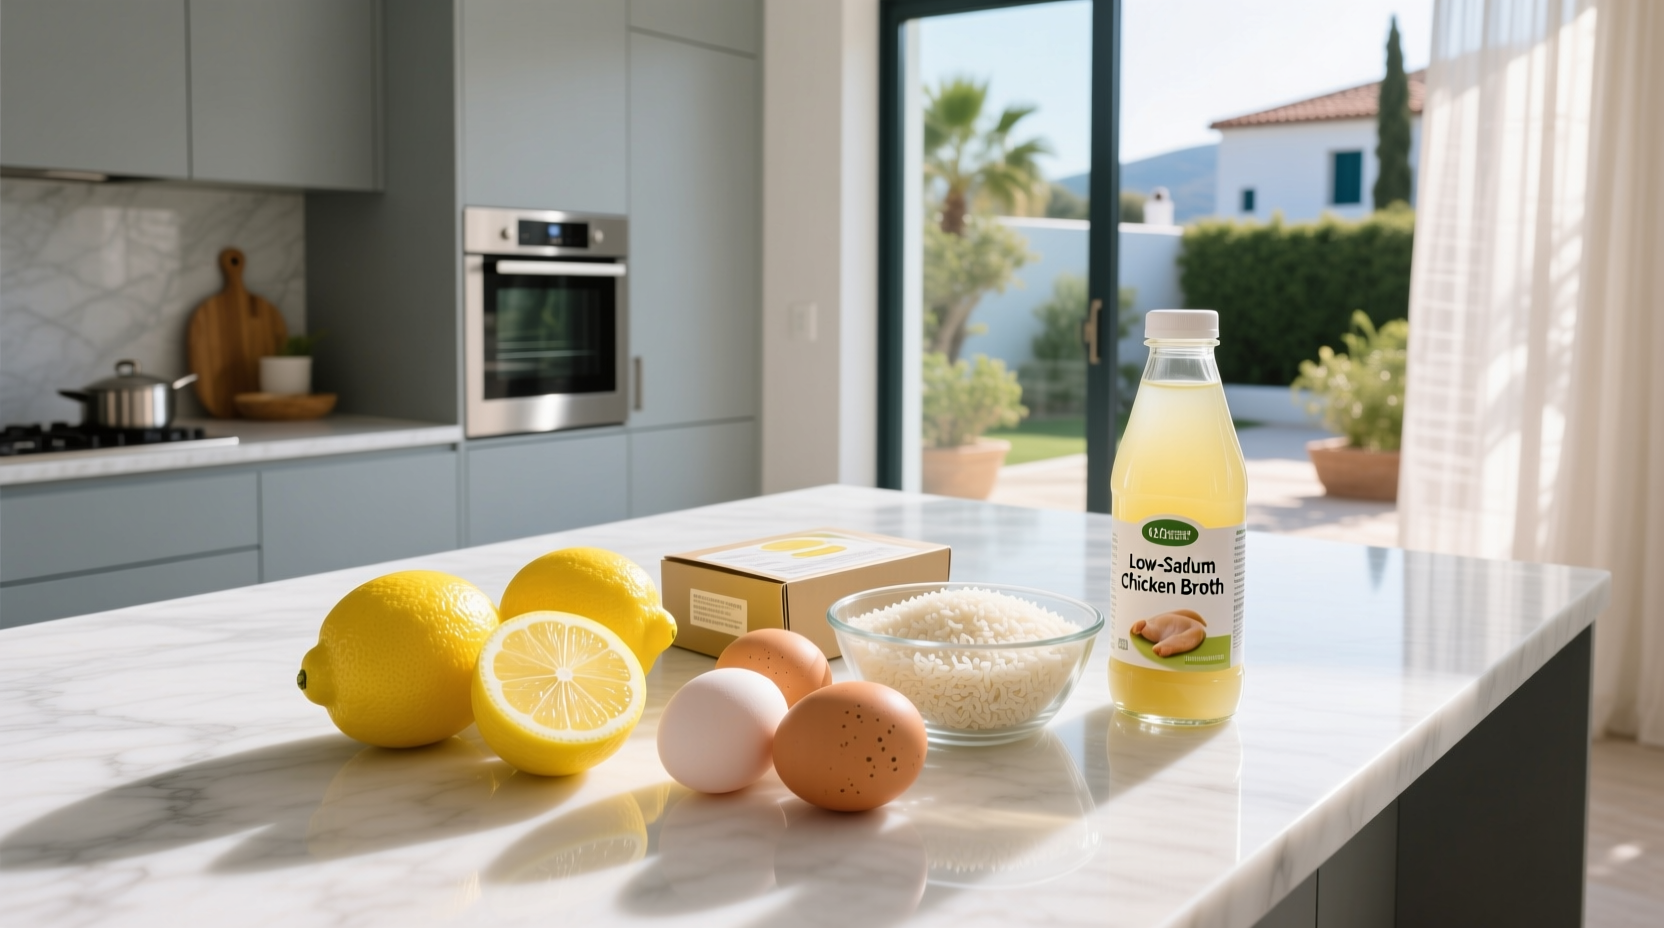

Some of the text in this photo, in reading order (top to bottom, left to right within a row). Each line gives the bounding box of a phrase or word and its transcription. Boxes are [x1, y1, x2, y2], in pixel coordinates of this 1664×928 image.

[1129, 553, 1216, 574] Low-Sadum
[1121, 572, 1224, 596] Chicken Broth
